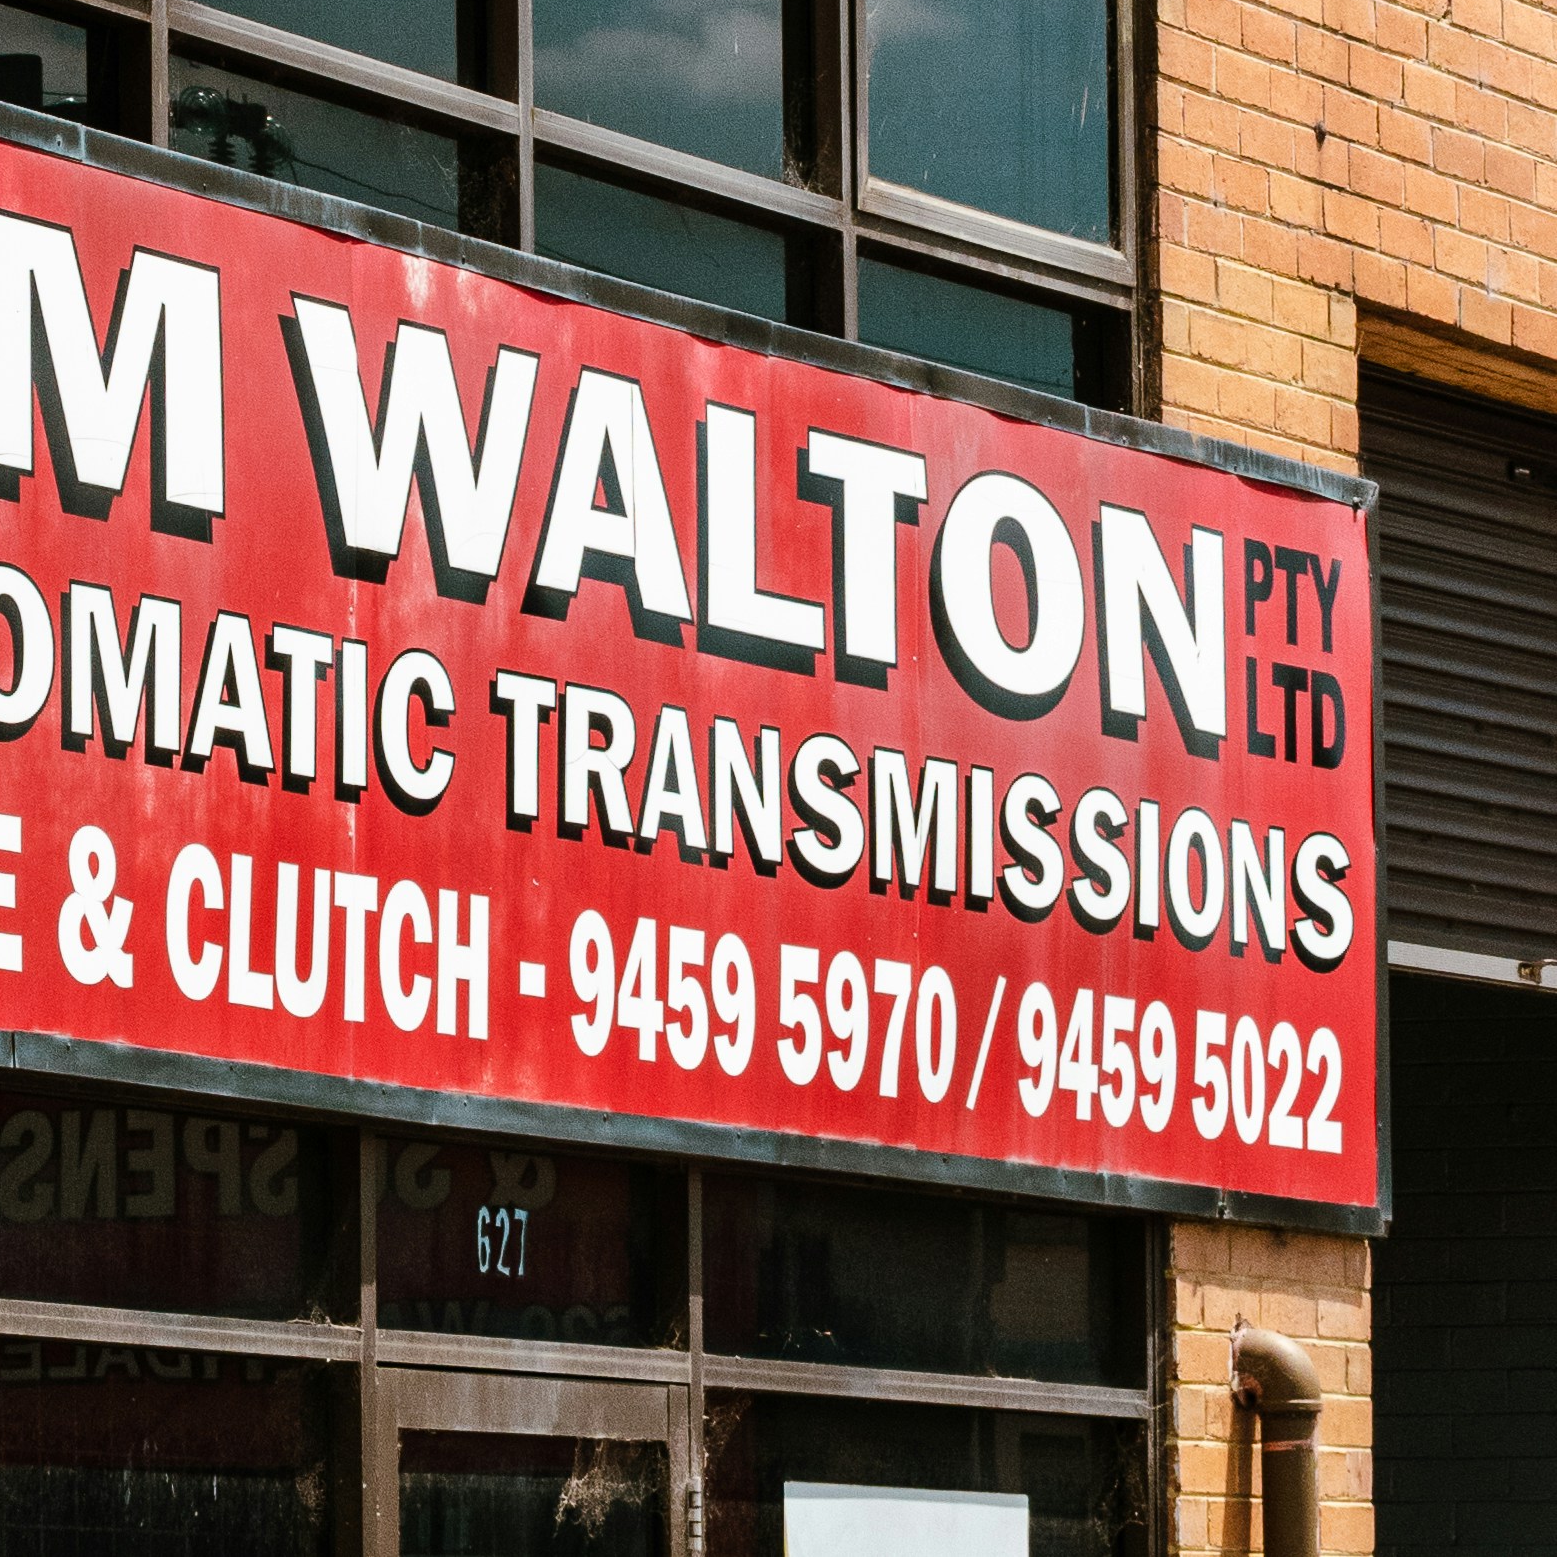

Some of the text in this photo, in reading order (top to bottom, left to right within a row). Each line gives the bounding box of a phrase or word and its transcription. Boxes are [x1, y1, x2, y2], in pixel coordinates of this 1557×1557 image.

[292, 297, 1228, 737] WALTON
[1244, 538, 1339, 652] PTY
[1246, 659, 1346, 769] LTD
[495, 672, 1355, 961] TRANSMISSIONS
[57, 825, 135, 989] &
[166, 843, 491, 1040] CLUTCH
[569, 909, 757, 1078] 9459
[777, 944, 958, 1103] 5970
[966, 976, 1007, 1110] /
[1017, 981, 1178, 1134] 9459
[1191, 1009, 1343, 1155] 5022
[475, 1204, 531, 1279] 627
